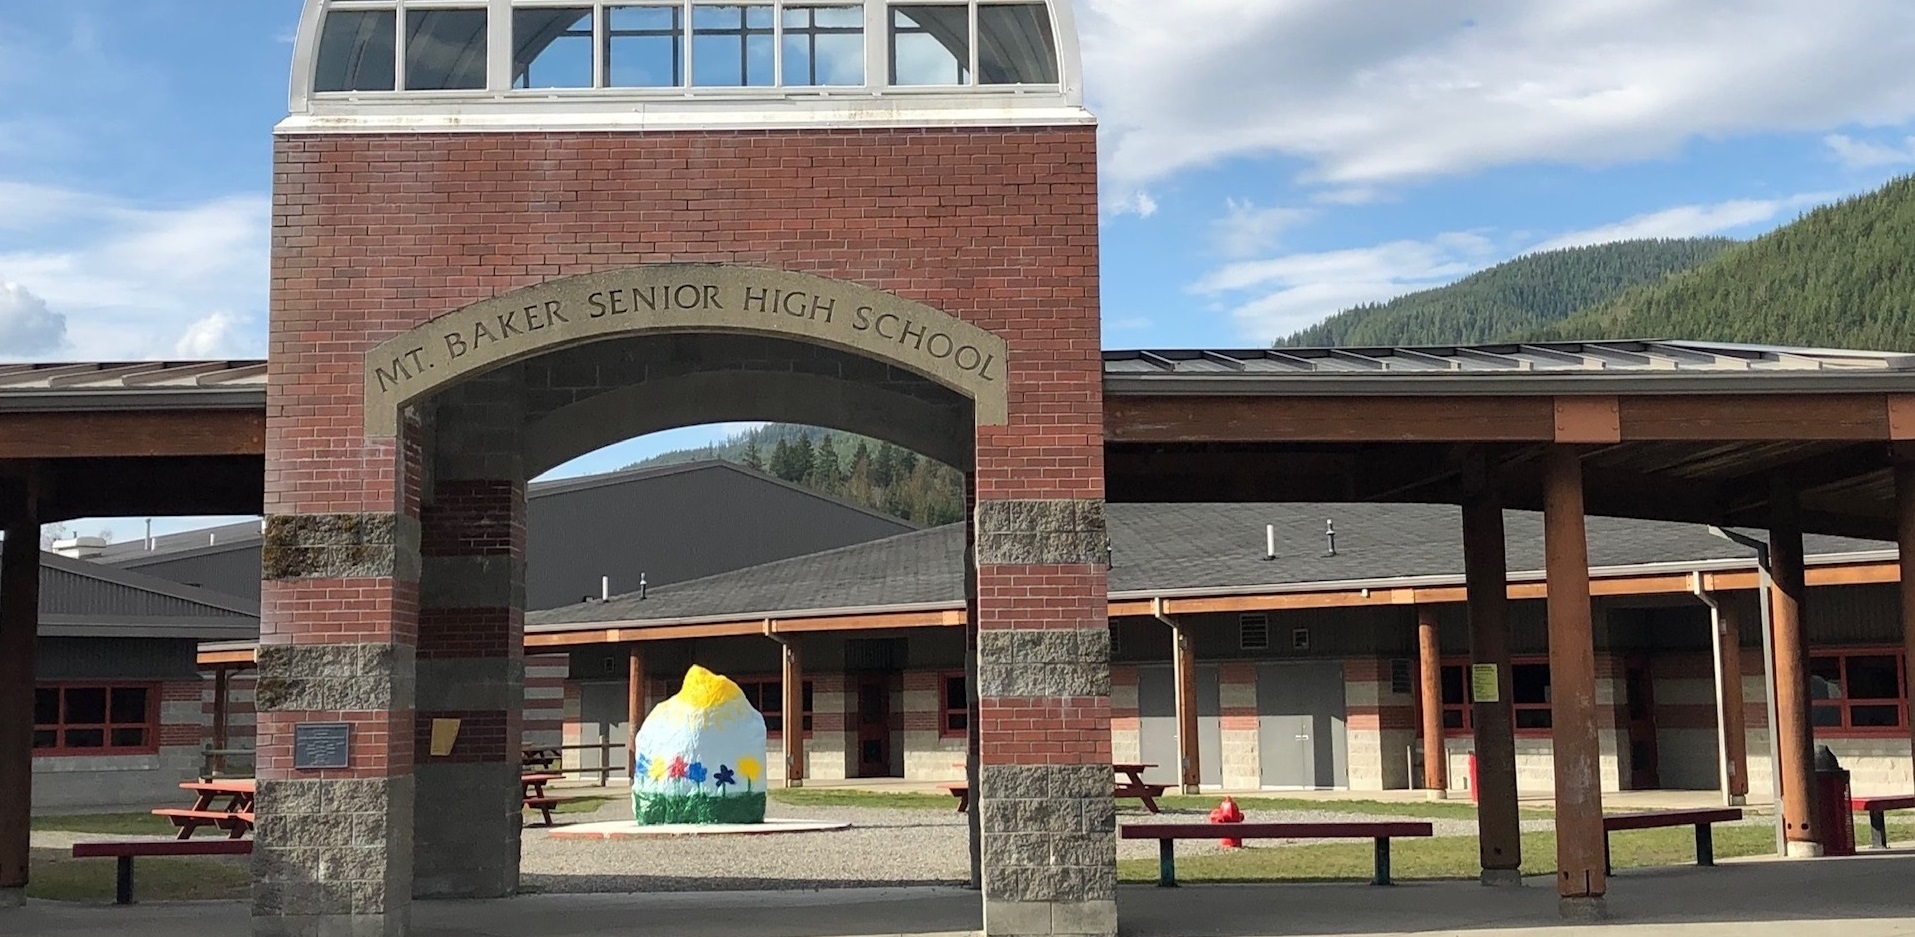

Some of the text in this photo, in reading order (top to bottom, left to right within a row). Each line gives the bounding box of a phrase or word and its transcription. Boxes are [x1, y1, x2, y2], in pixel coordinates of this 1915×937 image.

[374, 284, 996, 393] MT. BAKER SENIOR HIGH SCHOOL
